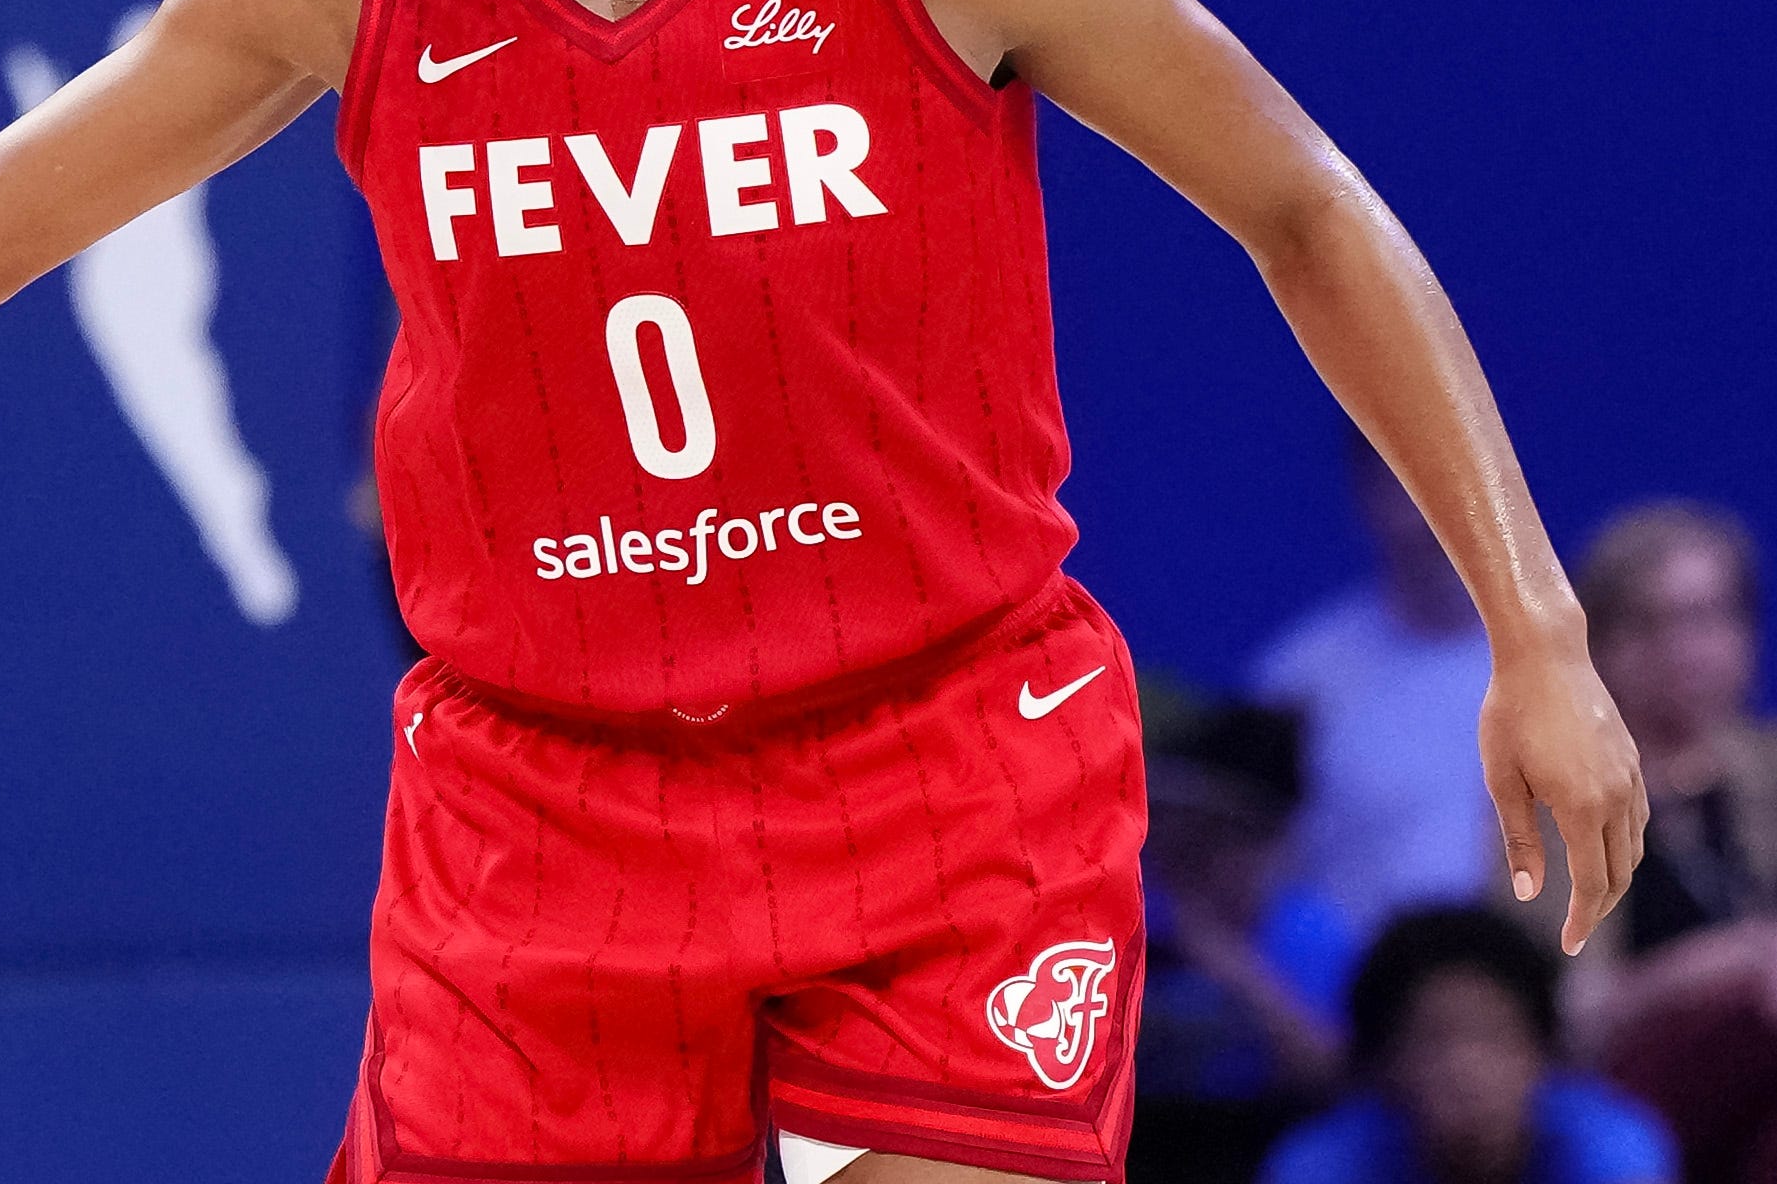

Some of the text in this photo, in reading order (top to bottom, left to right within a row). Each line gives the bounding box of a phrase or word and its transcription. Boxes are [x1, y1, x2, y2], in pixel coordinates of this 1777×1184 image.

[418, 103, 890, 262] FEVER
[604, 293, 717, 480] 0
[532, 501, 863, 585] salesforce
